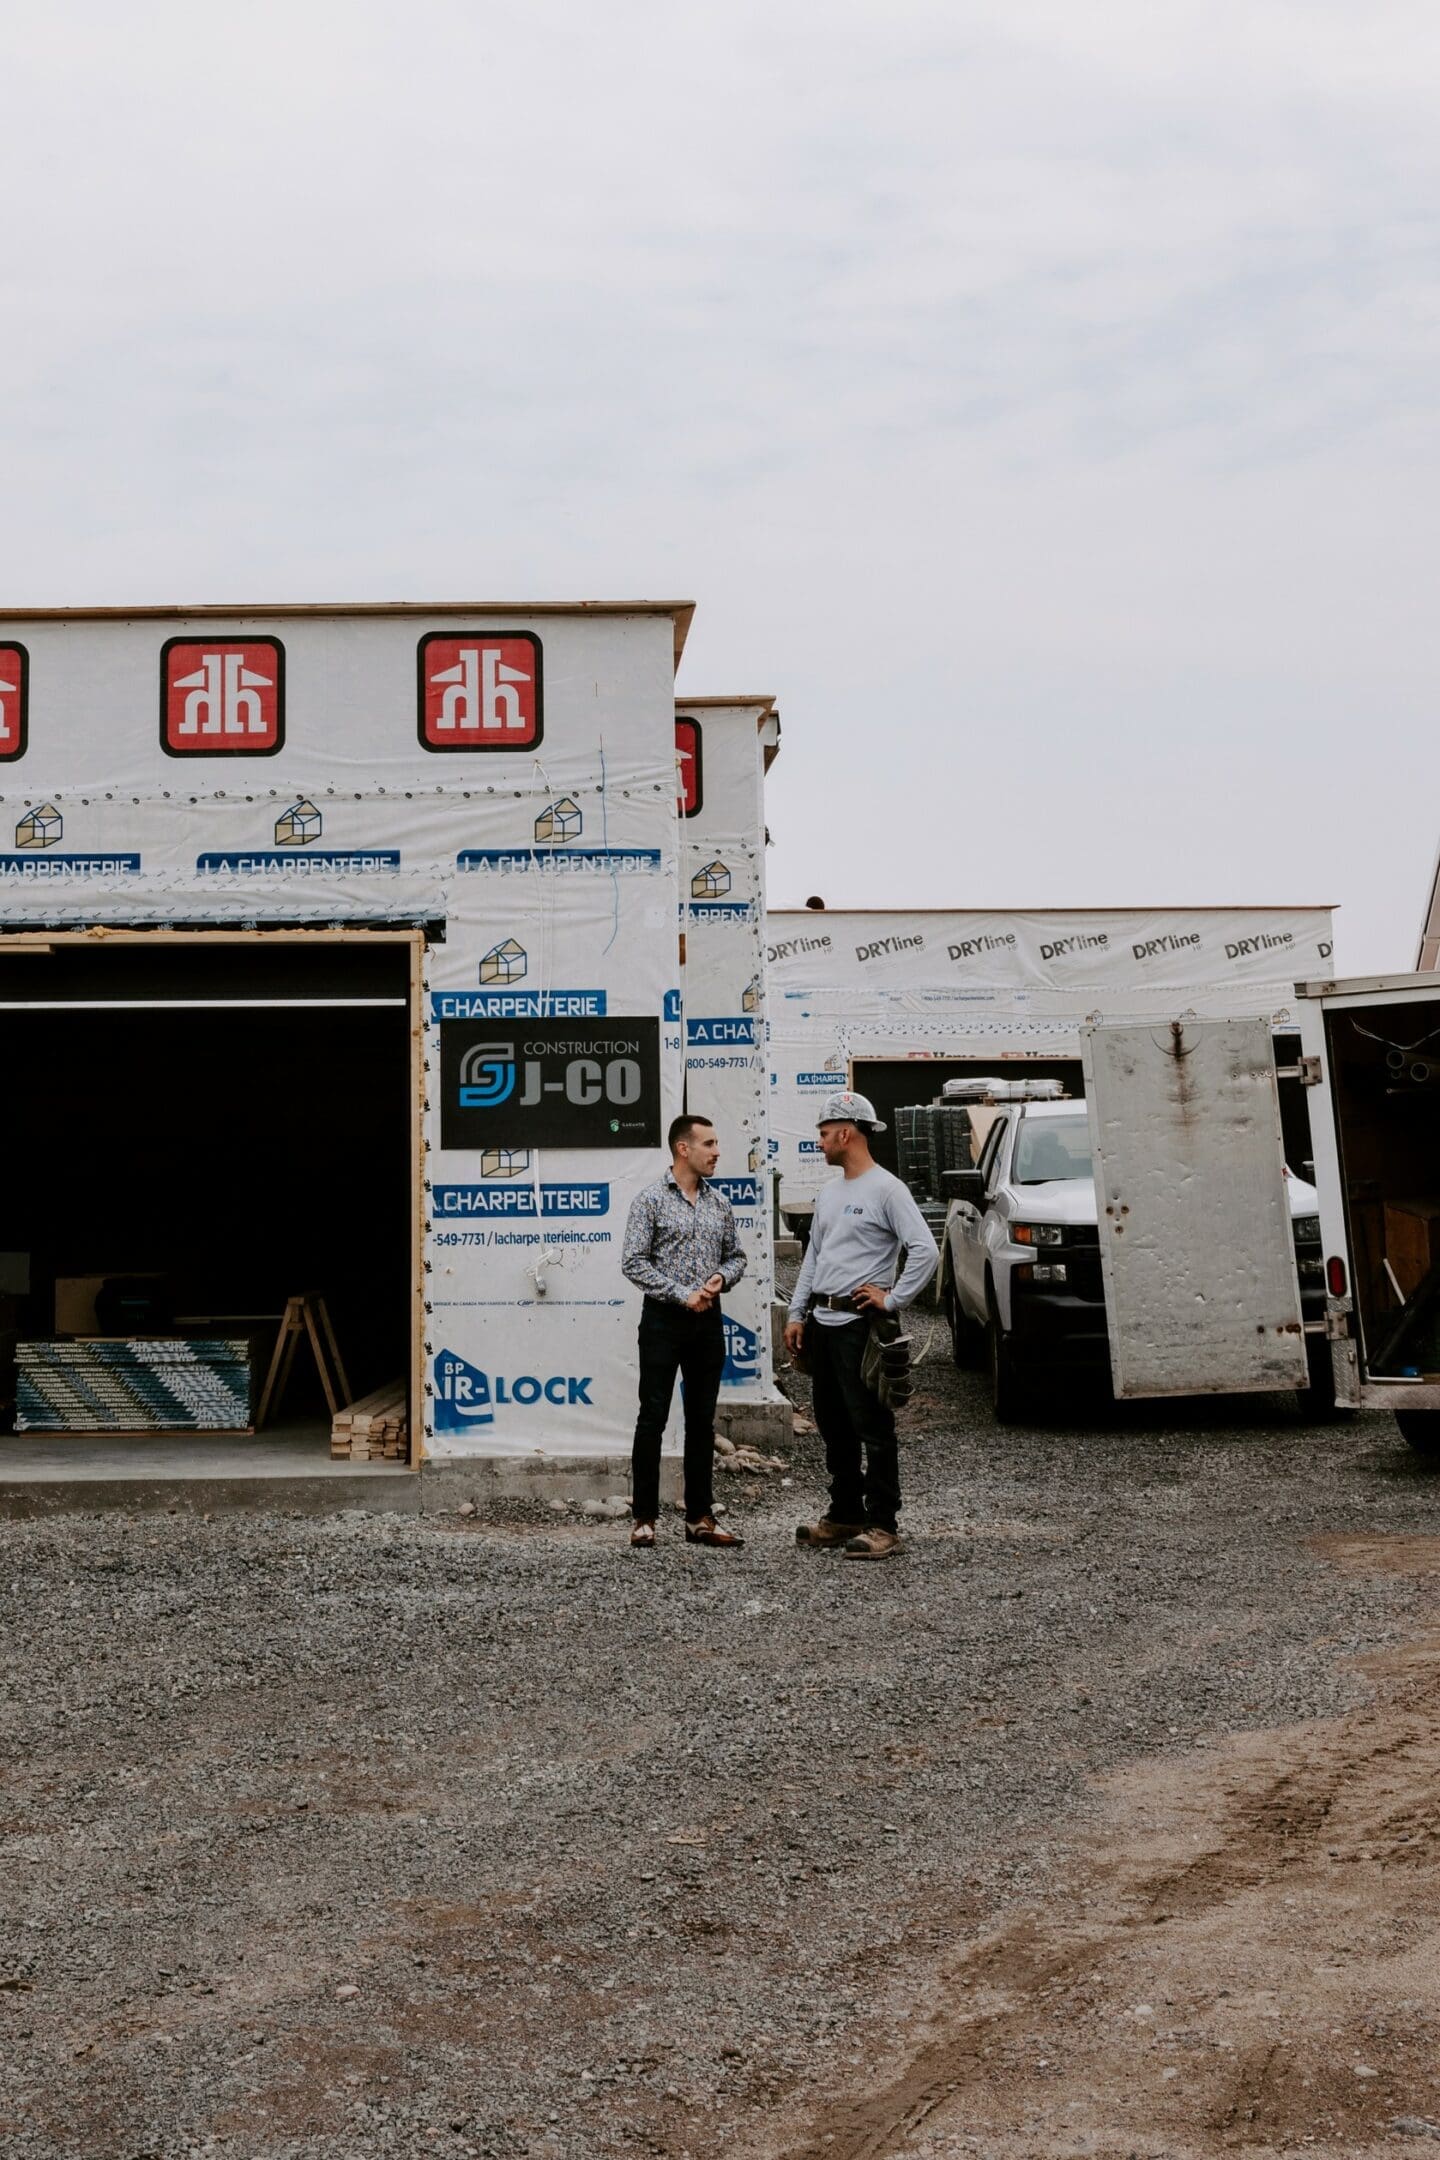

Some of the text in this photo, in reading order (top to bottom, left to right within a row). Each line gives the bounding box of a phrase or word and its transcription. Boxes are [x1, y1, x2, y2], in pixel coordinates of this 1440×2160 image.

[855, 934, 924, 962] DRYline
[947, 933, 1016, 961] DRYline
[1039, 933, 1108, 961] DRYline
[1132, 932, 1200, 960] DRYline
[1224, 932, 1293, 959] DRYline
[442, 997, 598, 1017] CHARPENTERIE
[523, 1041, 640, 1054] CONSTRUCTION
[520, 1059, 641, 1105] J-CO
[444, 1190, 601, 1211] CHARPENTERIE
[723, 1325, 739, 1335] BP
[444, 1362, 464, 1374] BP
[496, 1376, 593, 1404] LOCK
